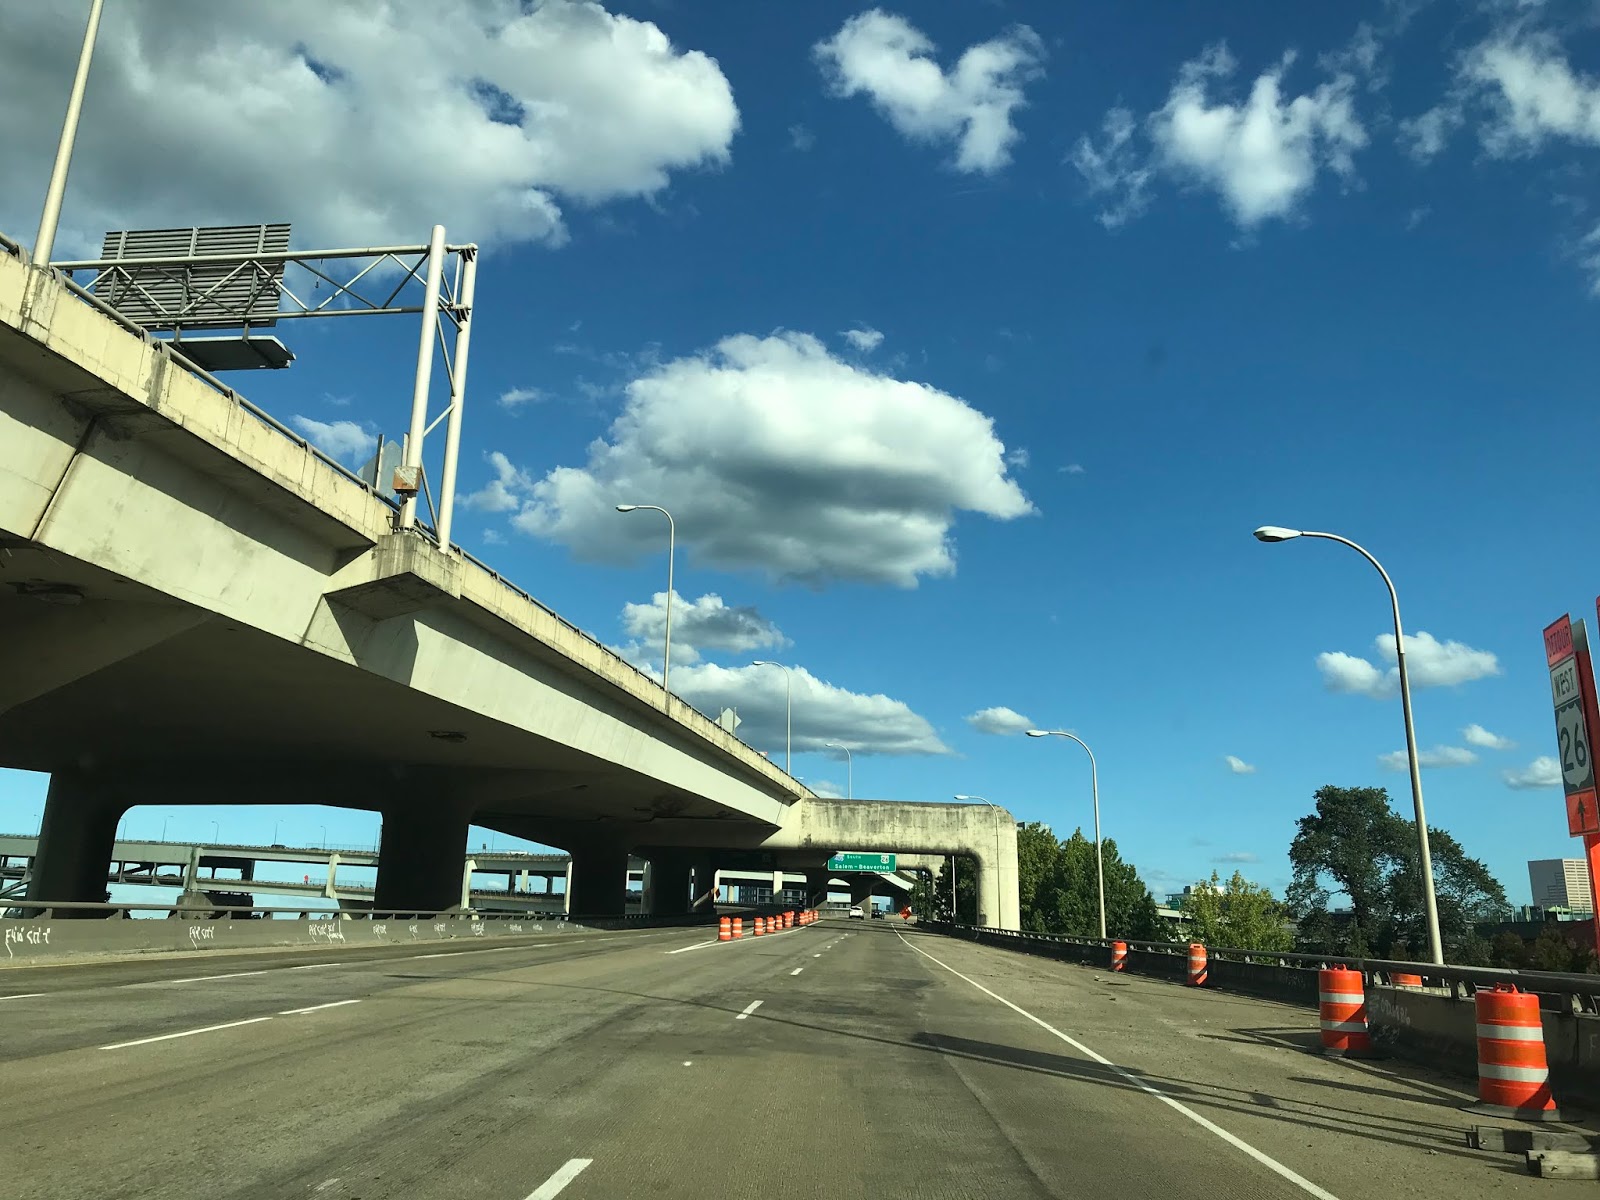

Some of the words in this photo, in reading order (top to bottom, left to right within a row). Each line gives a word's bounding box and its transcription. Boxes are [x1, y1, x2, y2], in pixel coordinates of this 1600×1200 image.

[1546, 626, 1570, 657] DETOUR
[1554, 667, 1574, 697] WEST
[1560, 722, 1587, 772] 26
